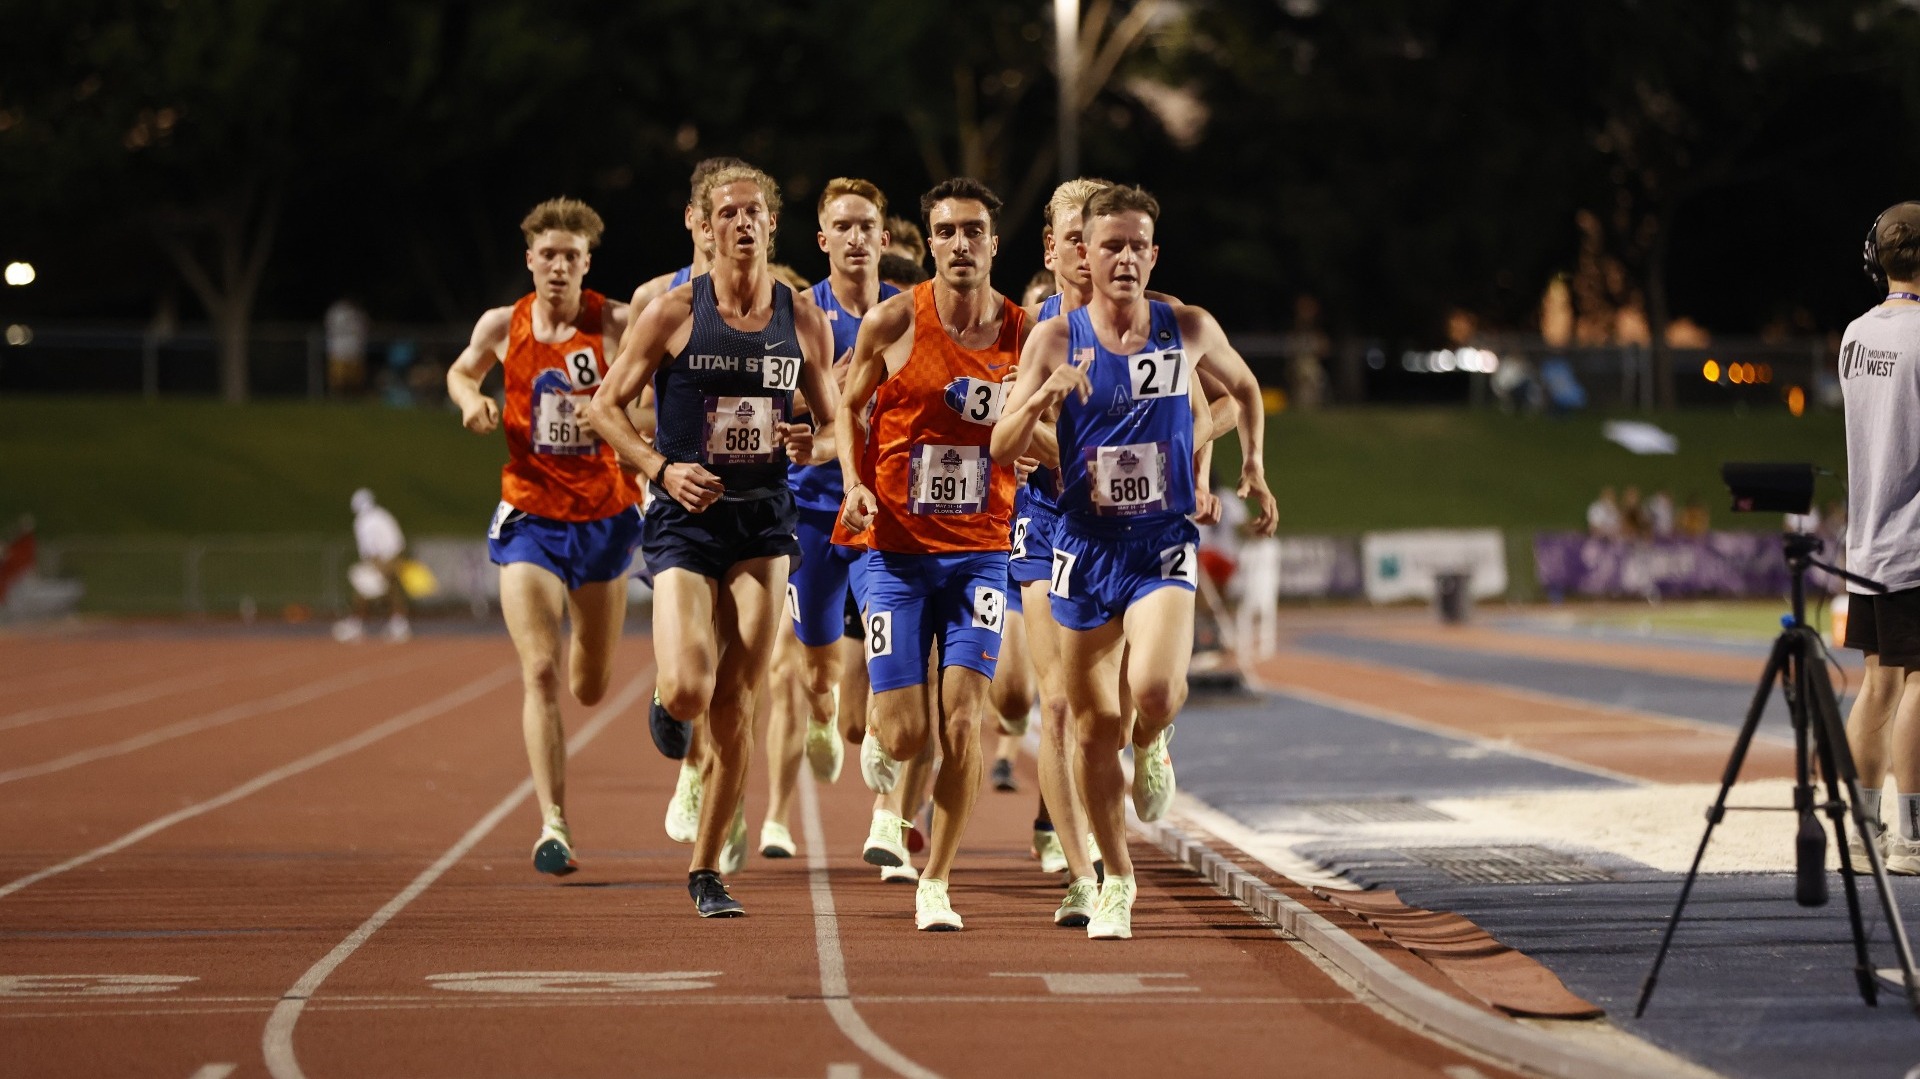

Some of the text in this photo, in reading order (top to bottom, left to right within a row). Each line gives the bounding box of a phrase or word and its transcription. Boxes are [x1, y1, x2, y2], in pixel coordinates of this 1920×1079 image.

[688, 354, 739, 371] UTAH
[1867, 359, 1895, 377] WEST
[1868, 349, 1898, 360] MOUNTAIN
[573, 352, 596, 387] 8
[768, 358, 795, 389] 30
[1137, 352, 1181, 396] 27
[548, 421, 581, 444] 561
[725, 427, 761, 452] 583
[931, 476, 967, 501] 591
[1110, 476, 1151, 503] 580
[1012, 523, 1026, 557] 2
[1055, 553, 1069, 592] 7
[1170, 550, 1188, 577] 2
[980, 592, 998, 627] 3
[871, 615, 887, 655] 8
